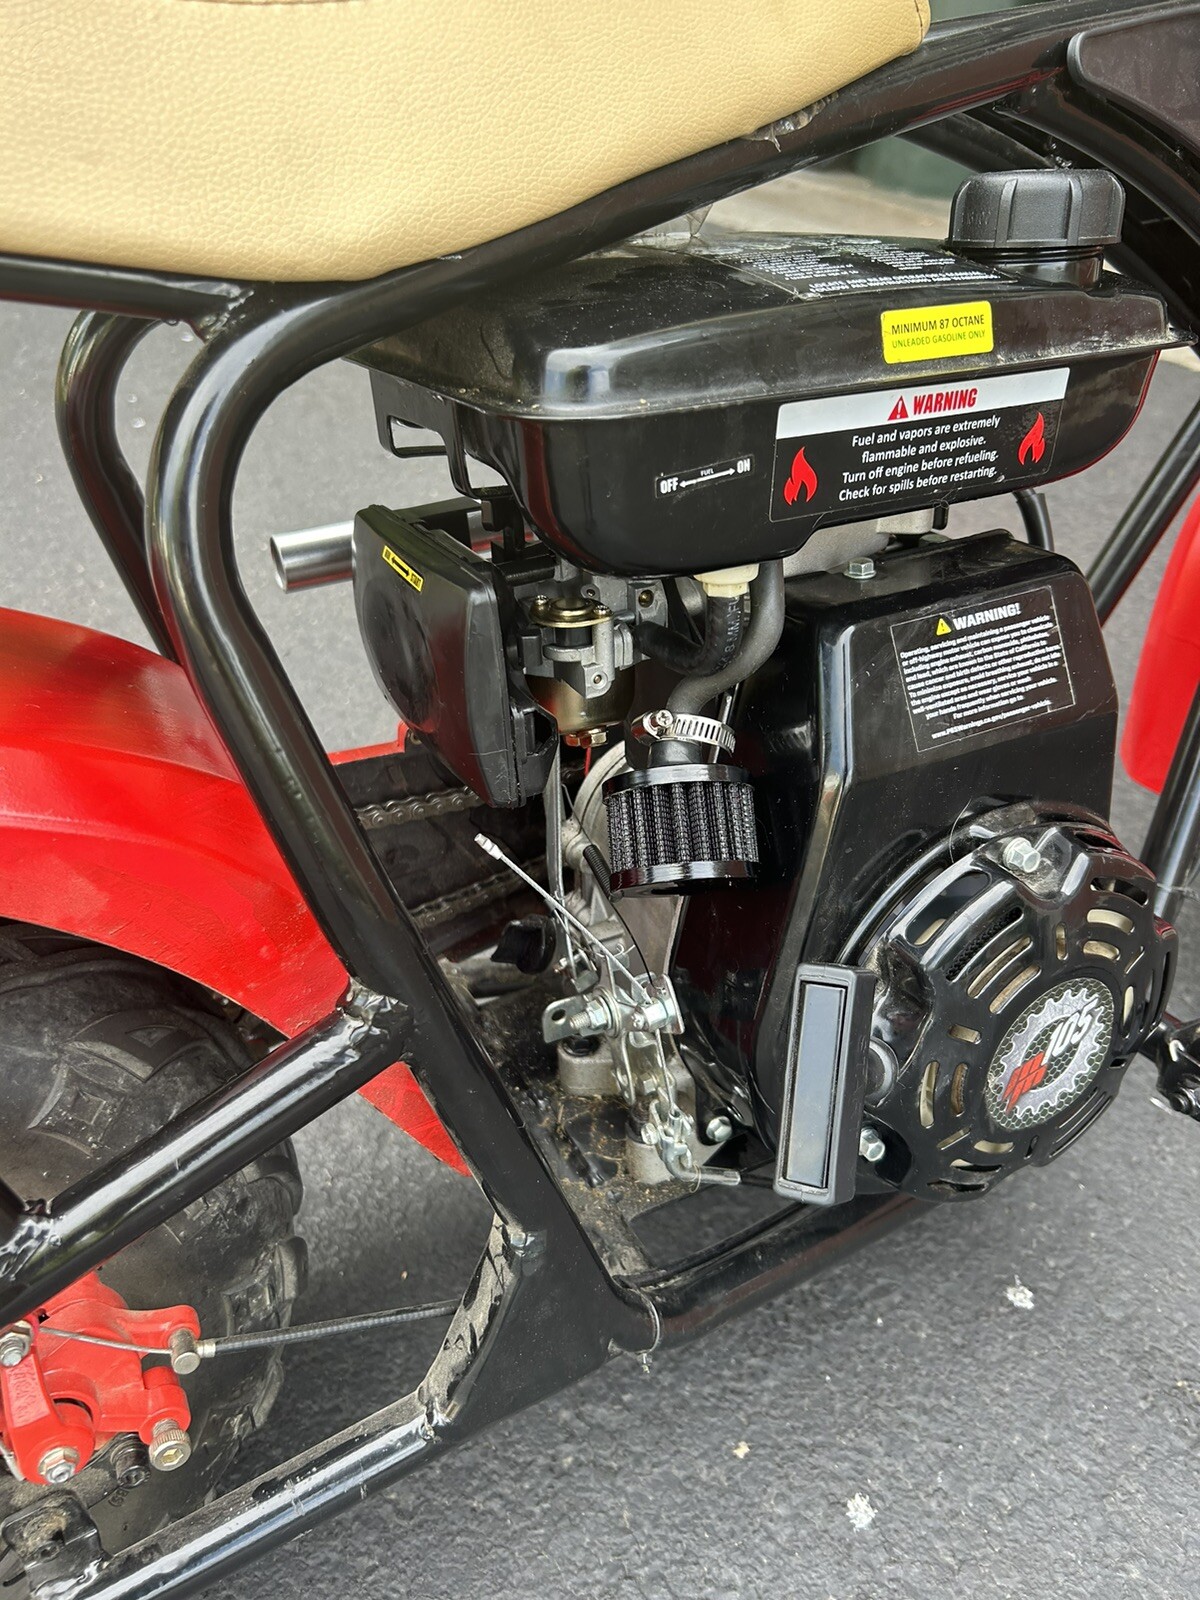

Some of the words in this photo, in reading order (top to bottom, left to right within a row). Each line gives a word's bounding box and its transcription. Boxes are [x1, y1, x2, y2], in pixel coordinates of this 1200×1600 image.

[891, 320, 936, 334] MINIMUM
[939, 318, 949, 329] 87
[952, 314, 984, 327] OCTANE
[891, 335, 931, 349] UNLEADED
[932, 331, 966, 344] GASOLINE
[967, 329, 986, 340] ONLY
[912, 387, 978, 414] WARNING
[852, 432, 875, 447] Fuel
[876, 429, 897, 443] and
[899, 427, 932, 441] vapors
[934, 424, 951, 435] are
[952, 414, 1001, 432] extremely
[861, 444, 916, 463] flammable
[918, 440, 938, 454] and
[939, 435, 986, 452] explosive.
[736, 458, 750, 473] ON
[842, 471, 866, 483] Turn
[868, 465, 884, 479] off
[884, 462, 919, 477] engine
[920, 457, 953, 471] before
[954, 449, 999, 466] refueling.
[660, 477, 678, 494] OFF
[838, 485, 870, 501] Check
[872, 483, 887, 495] for
[888, 478, 914, 494] spills
[916, 474, 948, 488] before
[949, 466, 997, 482] restarting.
[952, 602, 1021, 630] WARNING!
[1041, 997, 1098, 1066] 105
